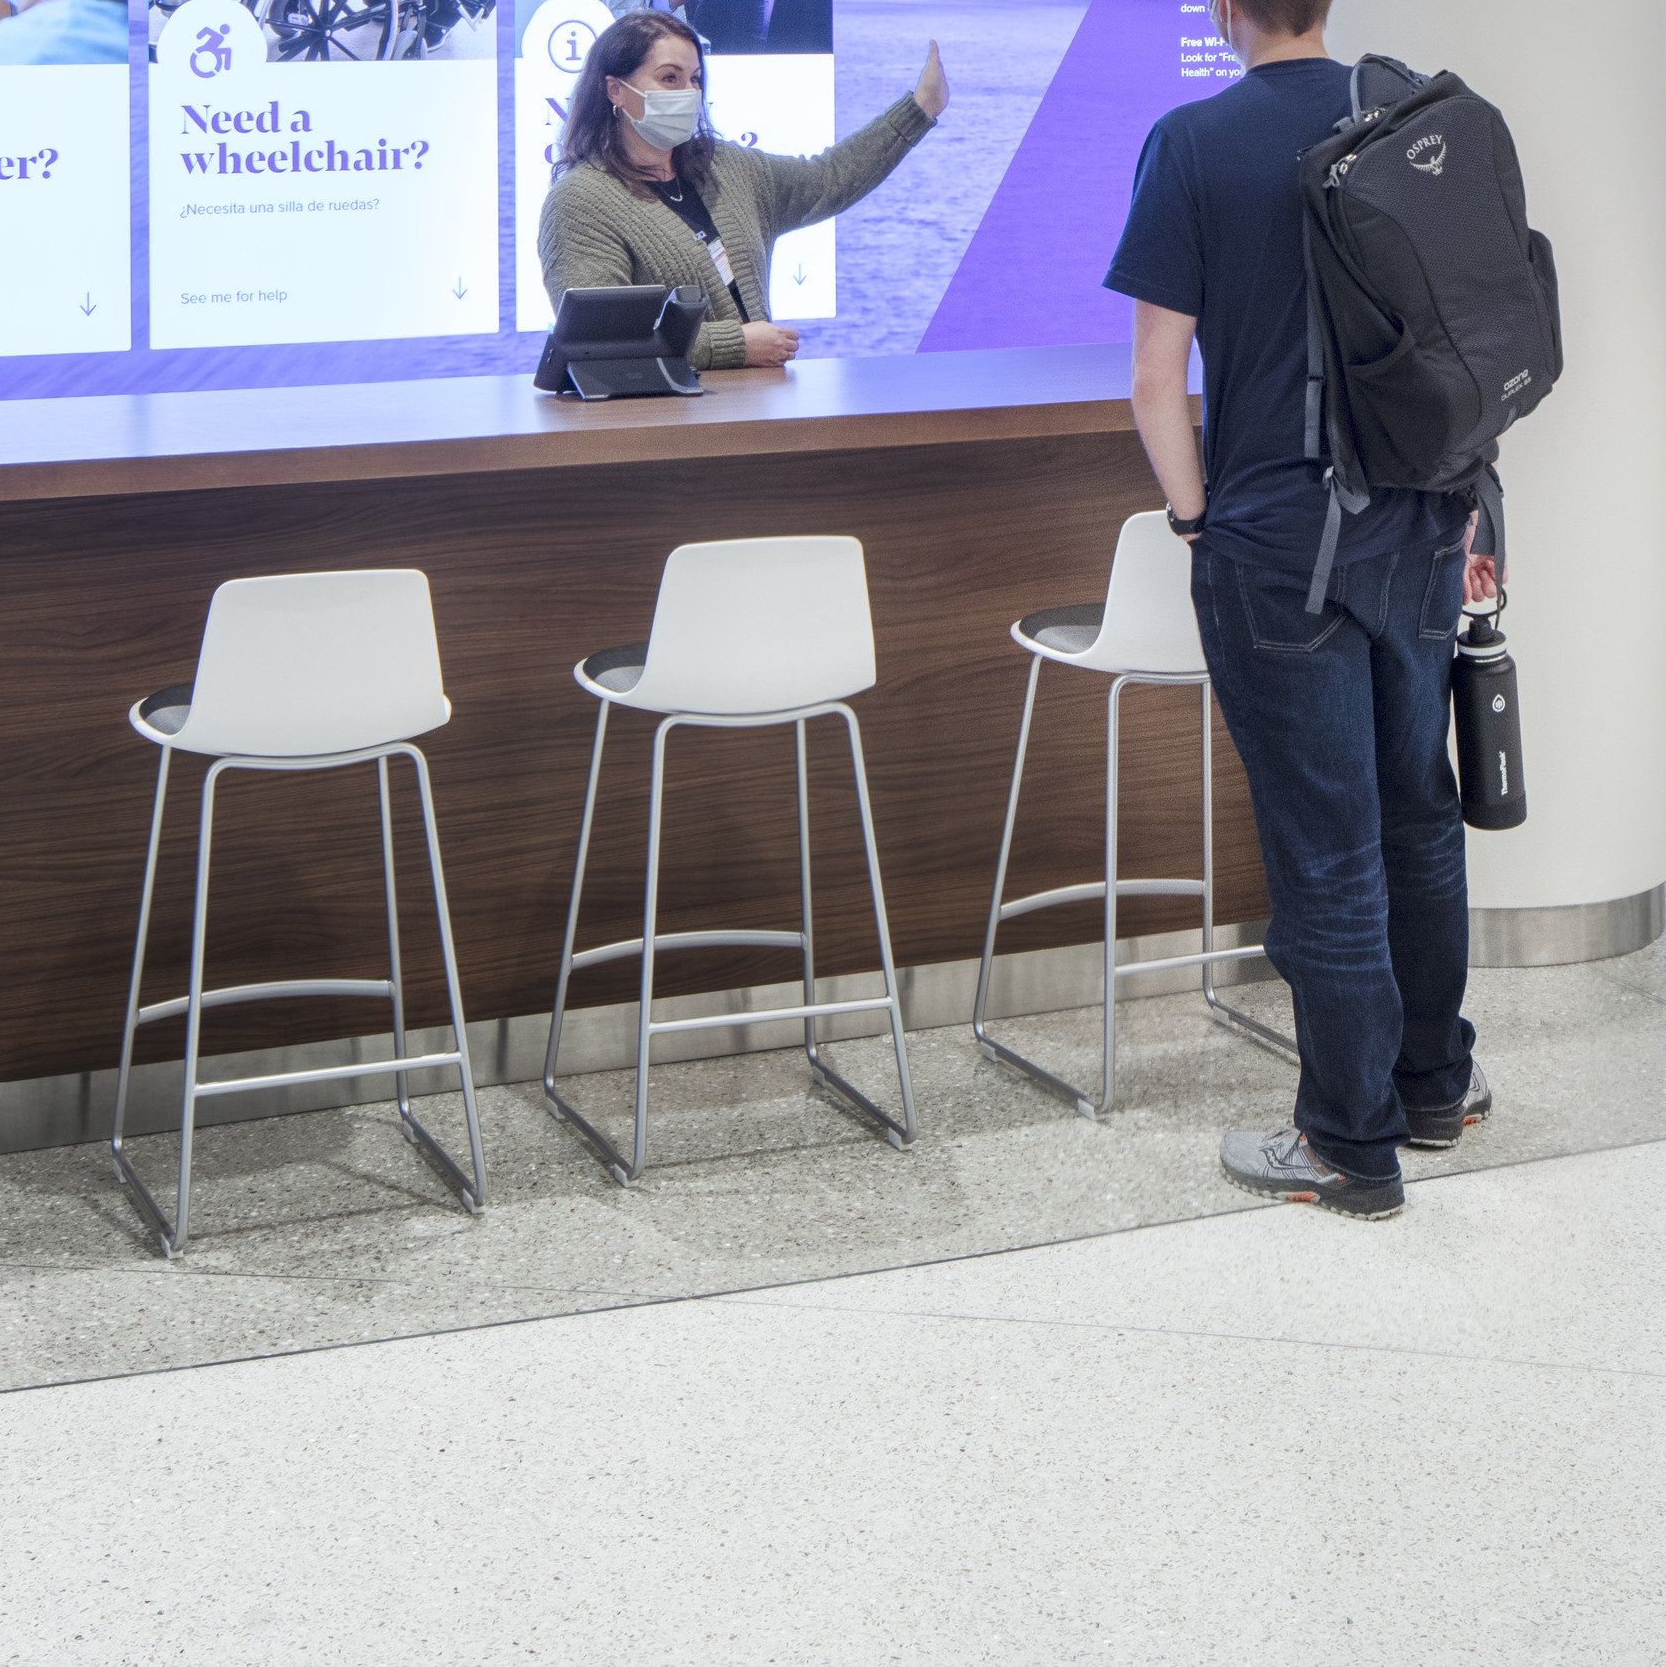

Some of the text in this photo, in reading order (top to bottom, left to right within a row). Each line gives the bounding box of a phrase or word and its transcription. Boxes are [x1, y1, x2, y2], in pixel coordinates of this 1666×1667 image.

[1180, 3, 1206, 12] down
[1180, 37, 1226, 47] Free Wi-F
[1181, 53, 1203, 62] Look
[1204, 53, 1218, 62] for
[1228, 69, 1241, 78] yo
[181, 100, 313, 134] Need a
[1406, 134, 1442, 160] OSPREY
[180, 138, 429, 174] wheelchair?
[180, 198, 380, 218] ¿Necesita una silla de ruedas?
[180, 289, 288, 304] See me for help
